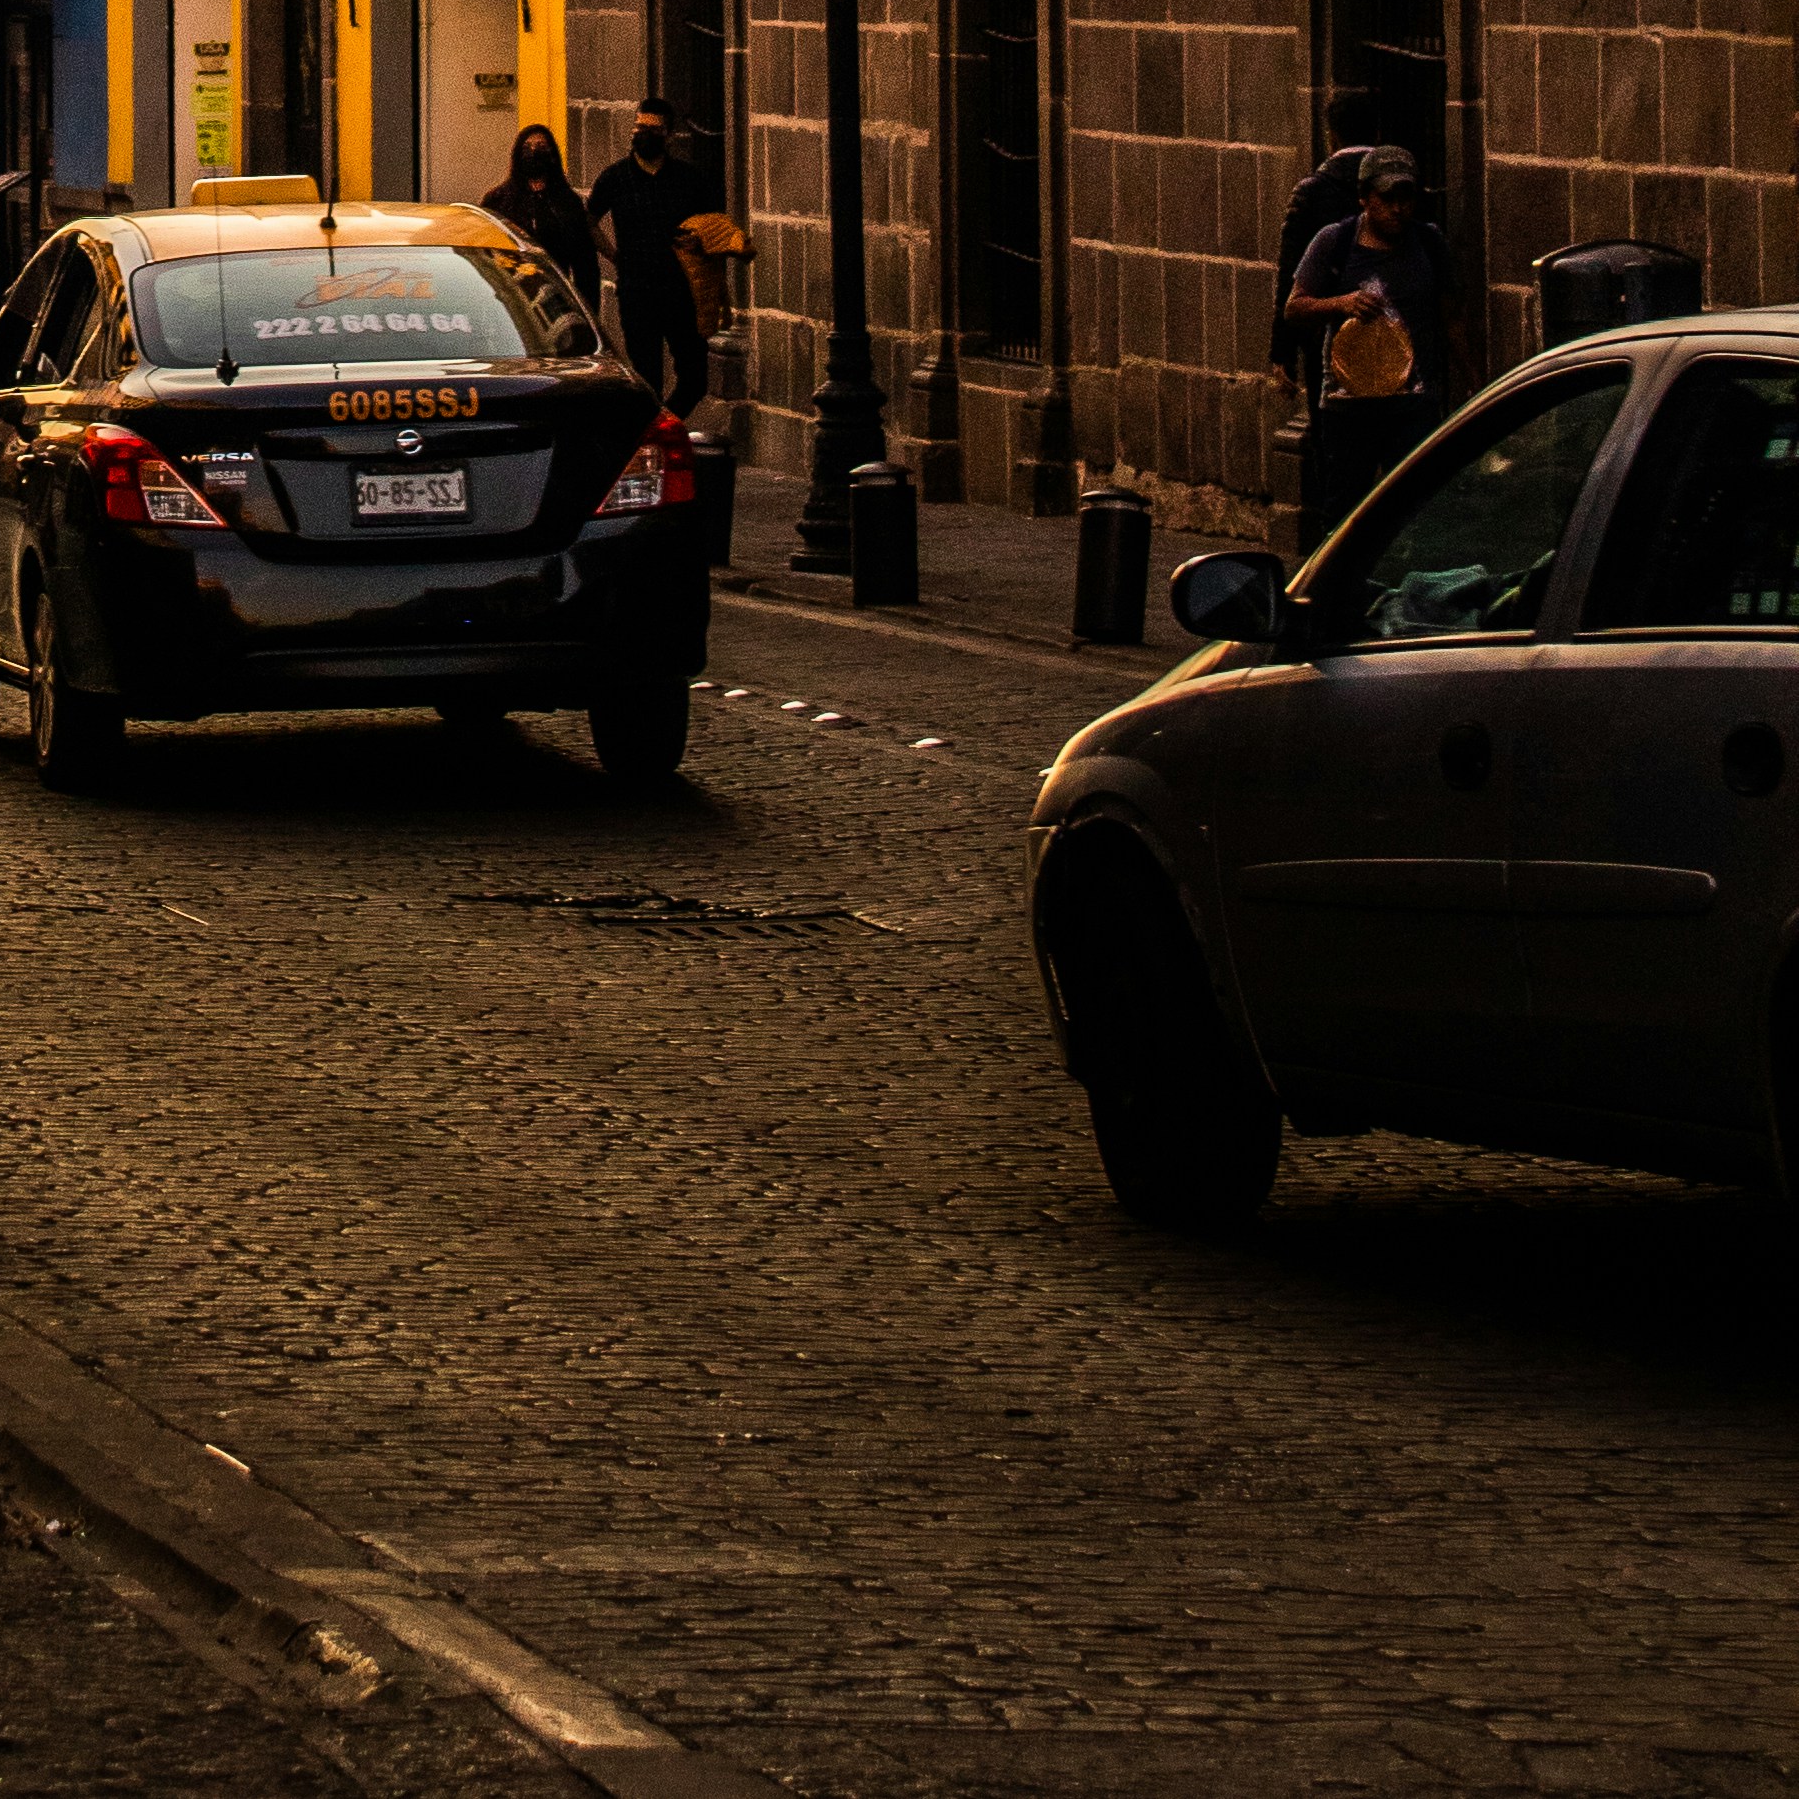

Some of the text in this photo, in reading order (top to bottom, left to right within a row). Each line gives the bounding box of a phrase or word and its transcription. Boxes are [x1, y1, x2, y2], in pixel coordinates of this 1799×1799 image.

[254, 312, 474, 340] 222 2 64 64 64
[328, 386, 481, 423] 6085SSJ
[181, 451, 255, 463] VERSA
[204, 470, 247, 481] NISSAN
